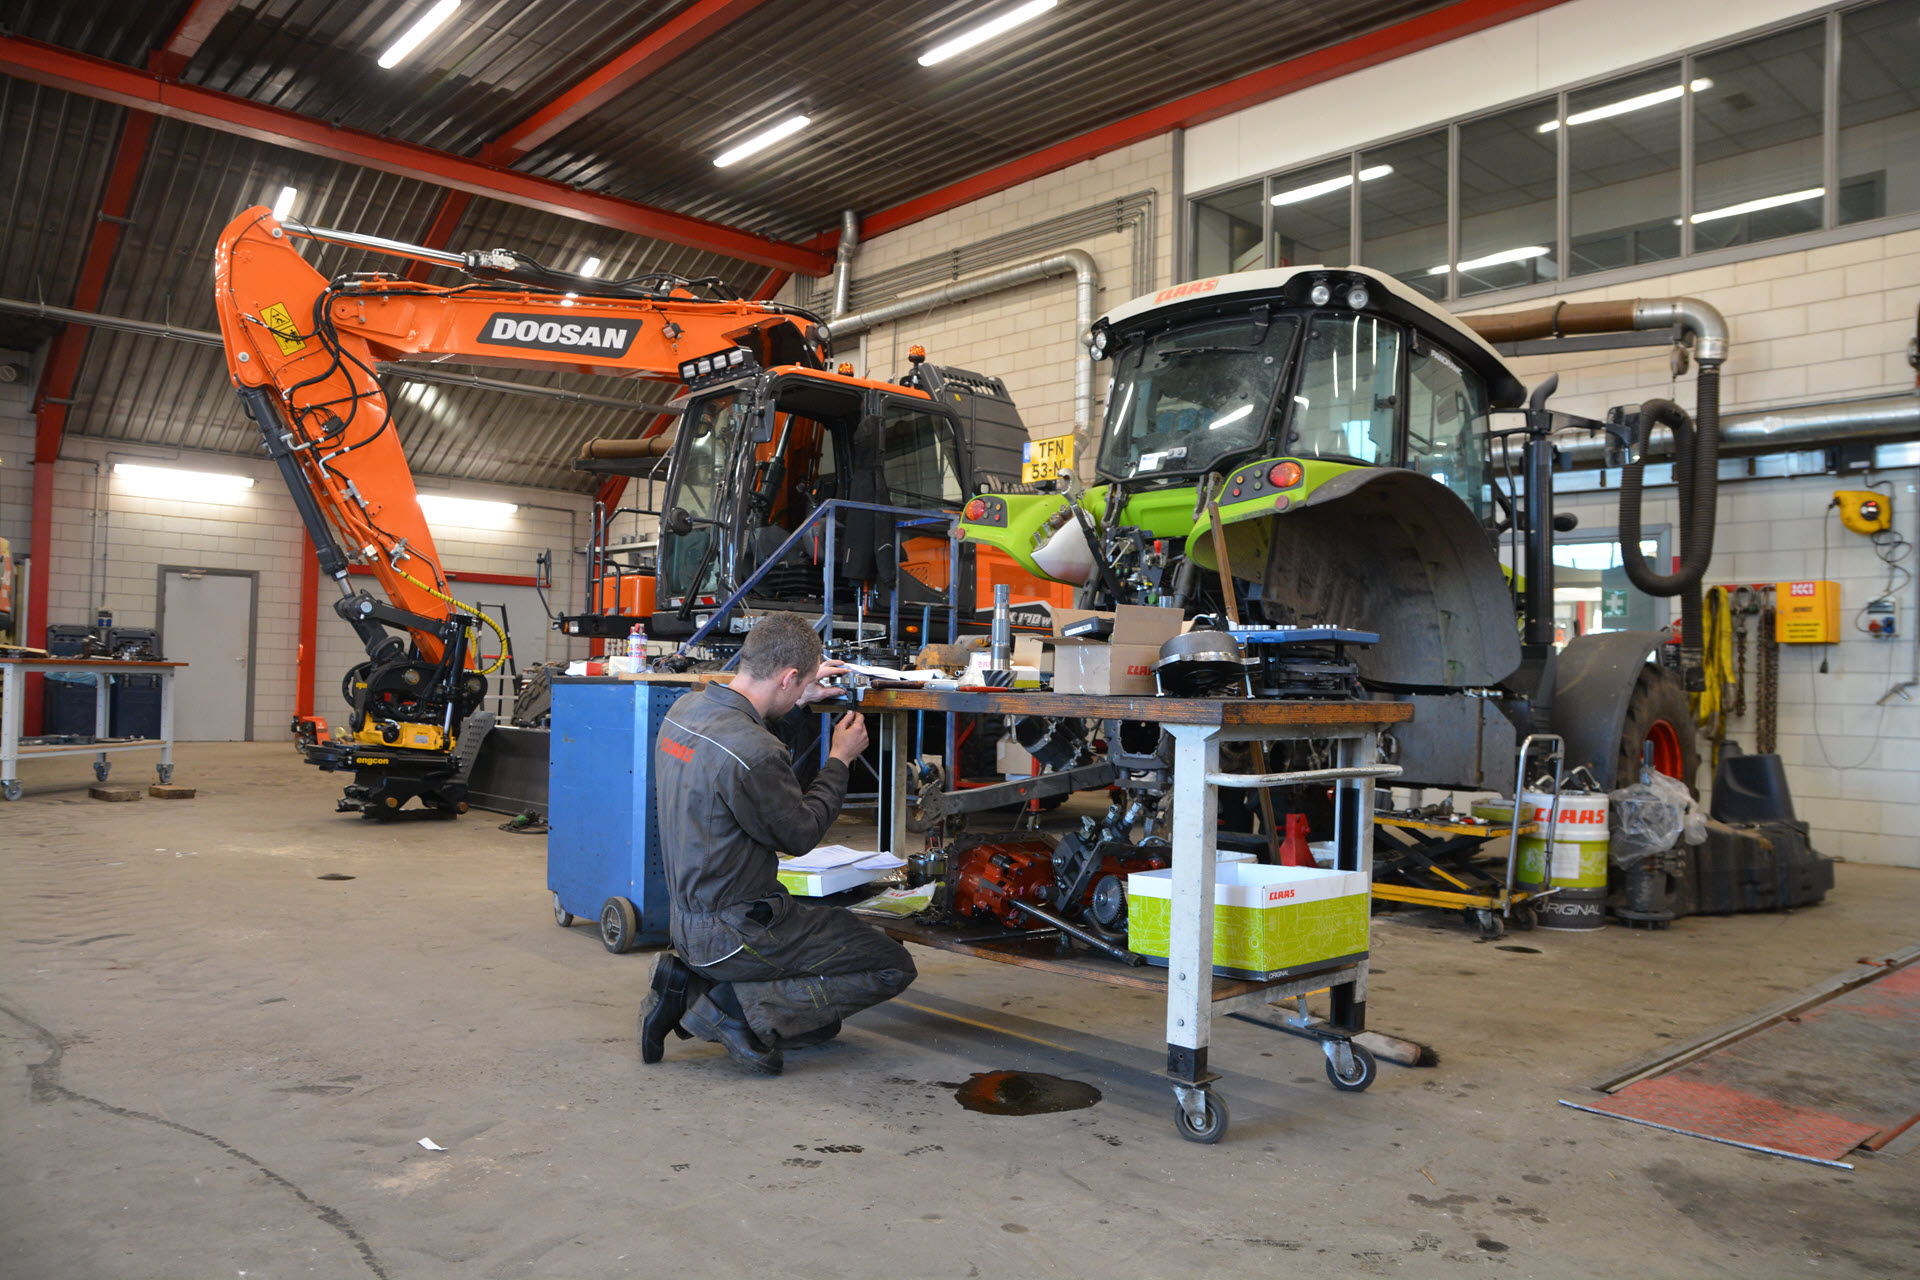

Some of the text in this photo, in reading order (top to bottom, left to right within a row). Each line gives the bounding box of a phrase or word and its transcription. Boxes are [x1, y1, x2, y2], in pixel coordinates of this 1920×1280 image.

[1153, 279, 1219, 304] CLAAS
[491, 317, 628, 350] DOOSAN
[1039, 439, 1064, 458] TFN
[1126, 665, 1152, 676] CLA
[660, 736, 696, 764] CLAAS
[356, 757, 390, 766] engcon
[1269, 889, 1295, 901] CLAAS
[1535, 901, 1601, 916] ORIGINAL
